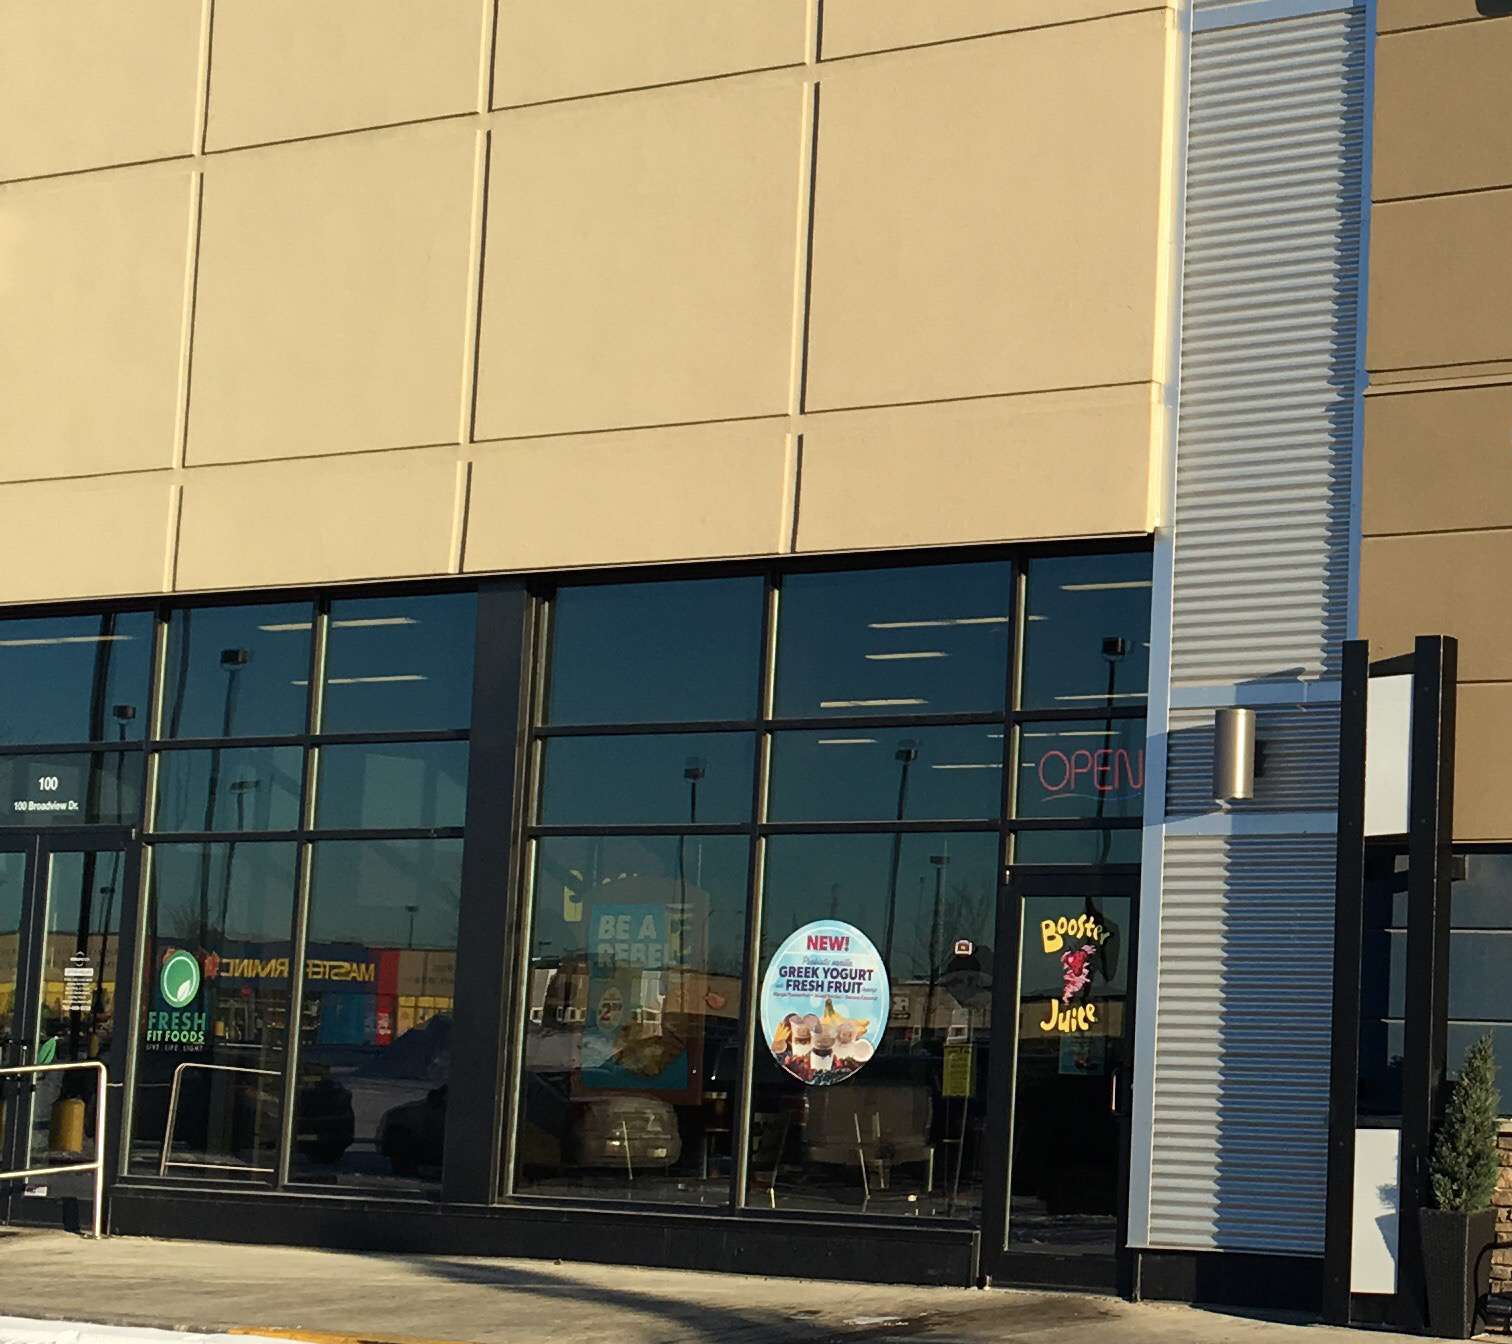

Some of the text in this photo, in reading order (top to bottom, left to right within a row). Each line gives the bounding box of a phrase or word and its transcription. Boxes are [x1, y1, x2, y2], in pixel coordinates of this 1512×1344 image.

[1039, 748, 1144, 791] OPEN
[38, 776, 59, 791] 100
[14, 801, 27, 811] 100
[599, 915, 657, 939] BE A
[1040, 914, 1110, 953] Booster
[807, 935, 850, 952] NEW!
[779, 966, 874, 981] GREEK YOGURT
[785, 979, 824, 992] FRESH
[827, 981, 863, 994] FRUIT
[148, 1011, 206, 1031] FRESH
[1040, 999, 1096, 1032] Juice
[146, 1030, 205, 1043] FIT FOODS
